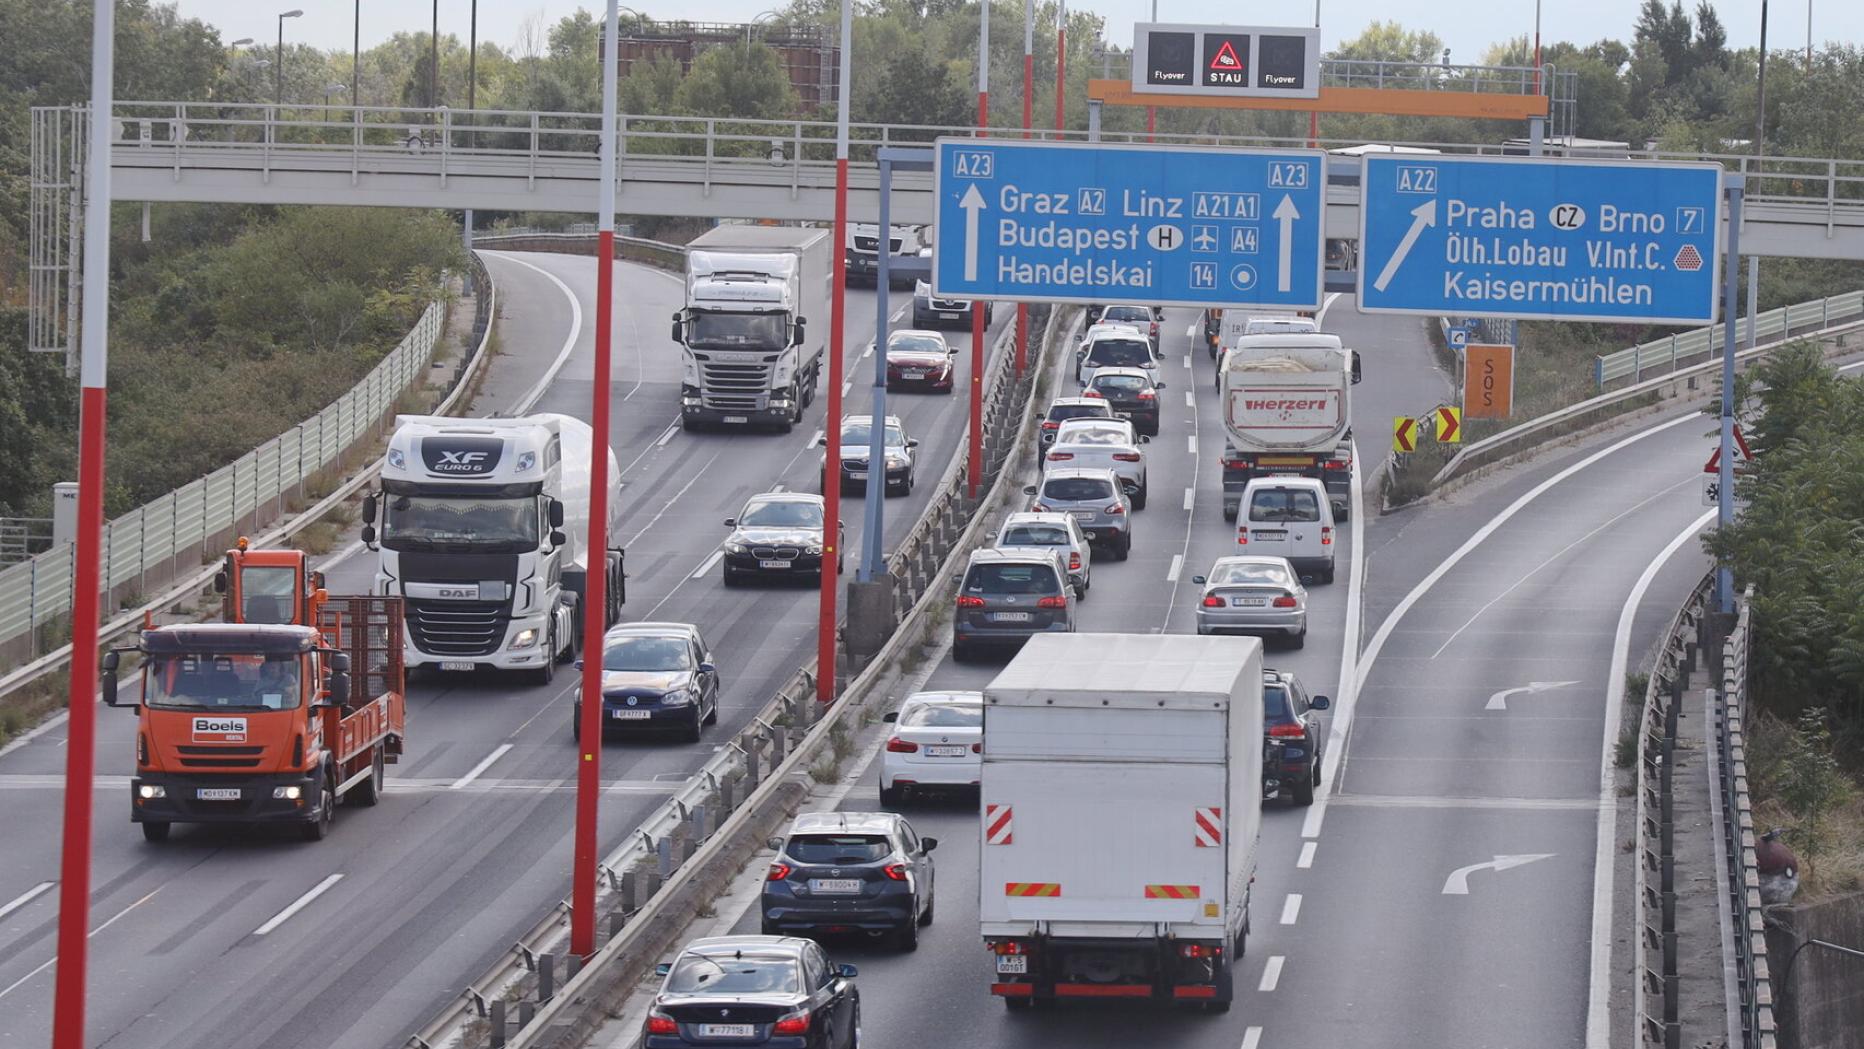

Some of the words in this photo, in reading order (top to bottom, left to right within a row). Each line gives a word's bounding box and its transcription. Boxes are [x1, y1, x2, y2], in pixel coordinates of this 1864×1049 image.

[1155, 71, 1185, 80] Flyover
[1210, 72, 1242, 83] STAU
[1265, 75, 1296, 84] Flyover
[956, 154, 992, 176] A23
[1271, 164, 1306, 186] A23
[1400, 169, 1435, 191] A22
[1000, 184, 1069, 214] Graz
[1080, 191, 1103, 213] A2
[1123, 189, 1183, 218] Linz
[1196, 195, 1229, 216] A21
[1234, 196, 1255, 217] A1
[1447, 199, 1535, 229] Praha
[1556, 206, 1578, 227] CZ
[1600, 204, 1665, 233] Brno
[1683, 210, 1697, 231] 7
[999, 218, 1140, 256] Budapest
[1233, 230, 1256, 251] A4
[1446, 231, 1566, 266] Ölh.Lobau
[998, 255, 1152, 287] Handelskai
[1194, 265, 1213, 286] 14
[1444, 271, 1652, 305] Kaisermühlen
[1484, 359, 1494, 407] SOS
[438, 451, 488, 463] XF
[439, 589, 477, 597] DAF
[195, 720, 244, 731] Boels
